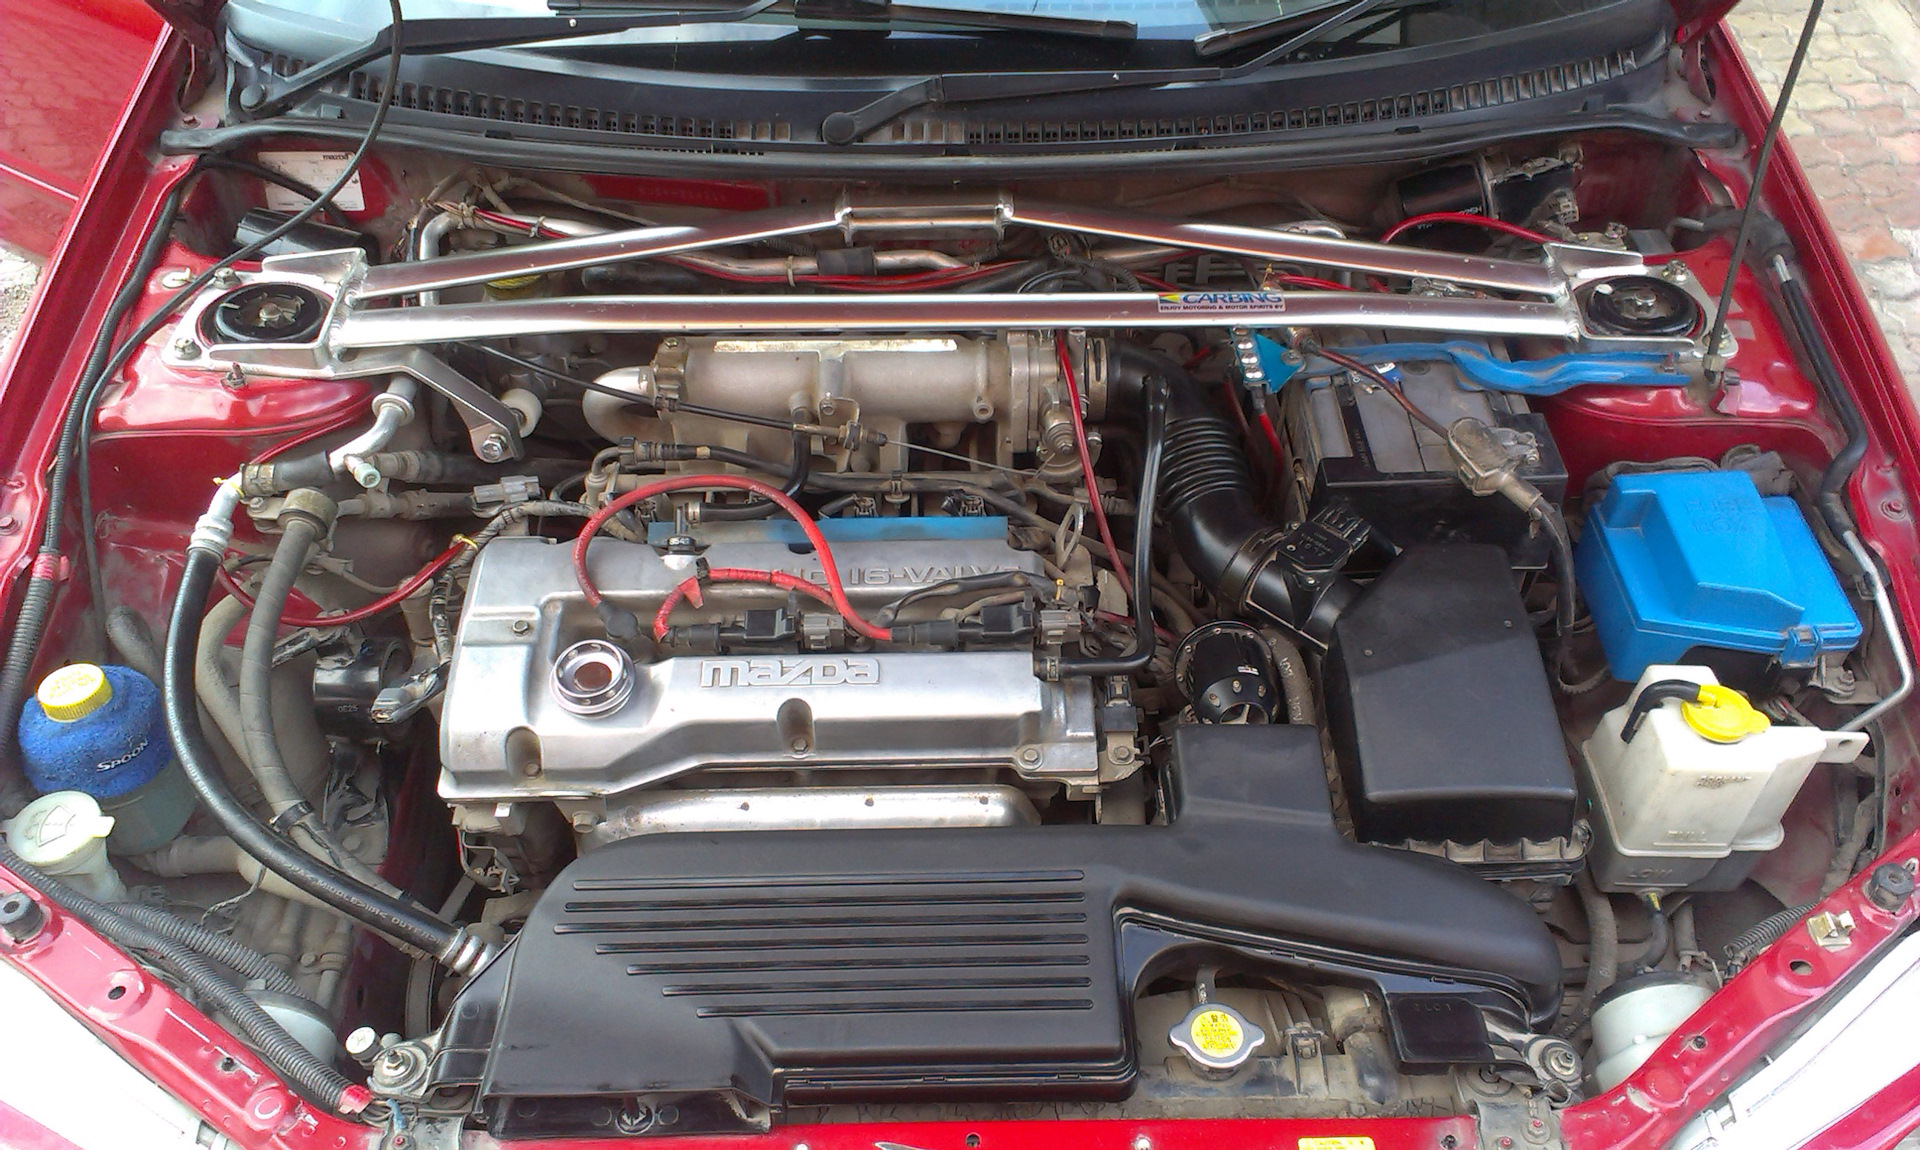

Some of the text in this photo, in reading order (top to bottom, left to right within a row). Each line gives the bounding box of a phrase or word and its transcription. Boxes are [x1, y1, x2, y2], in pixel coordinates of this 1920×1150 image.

[1182, 292, 1283, 305] CARBING
[850, 566, 1020, 585] 16-VALV
[700, 658, 880, 689] mazda
